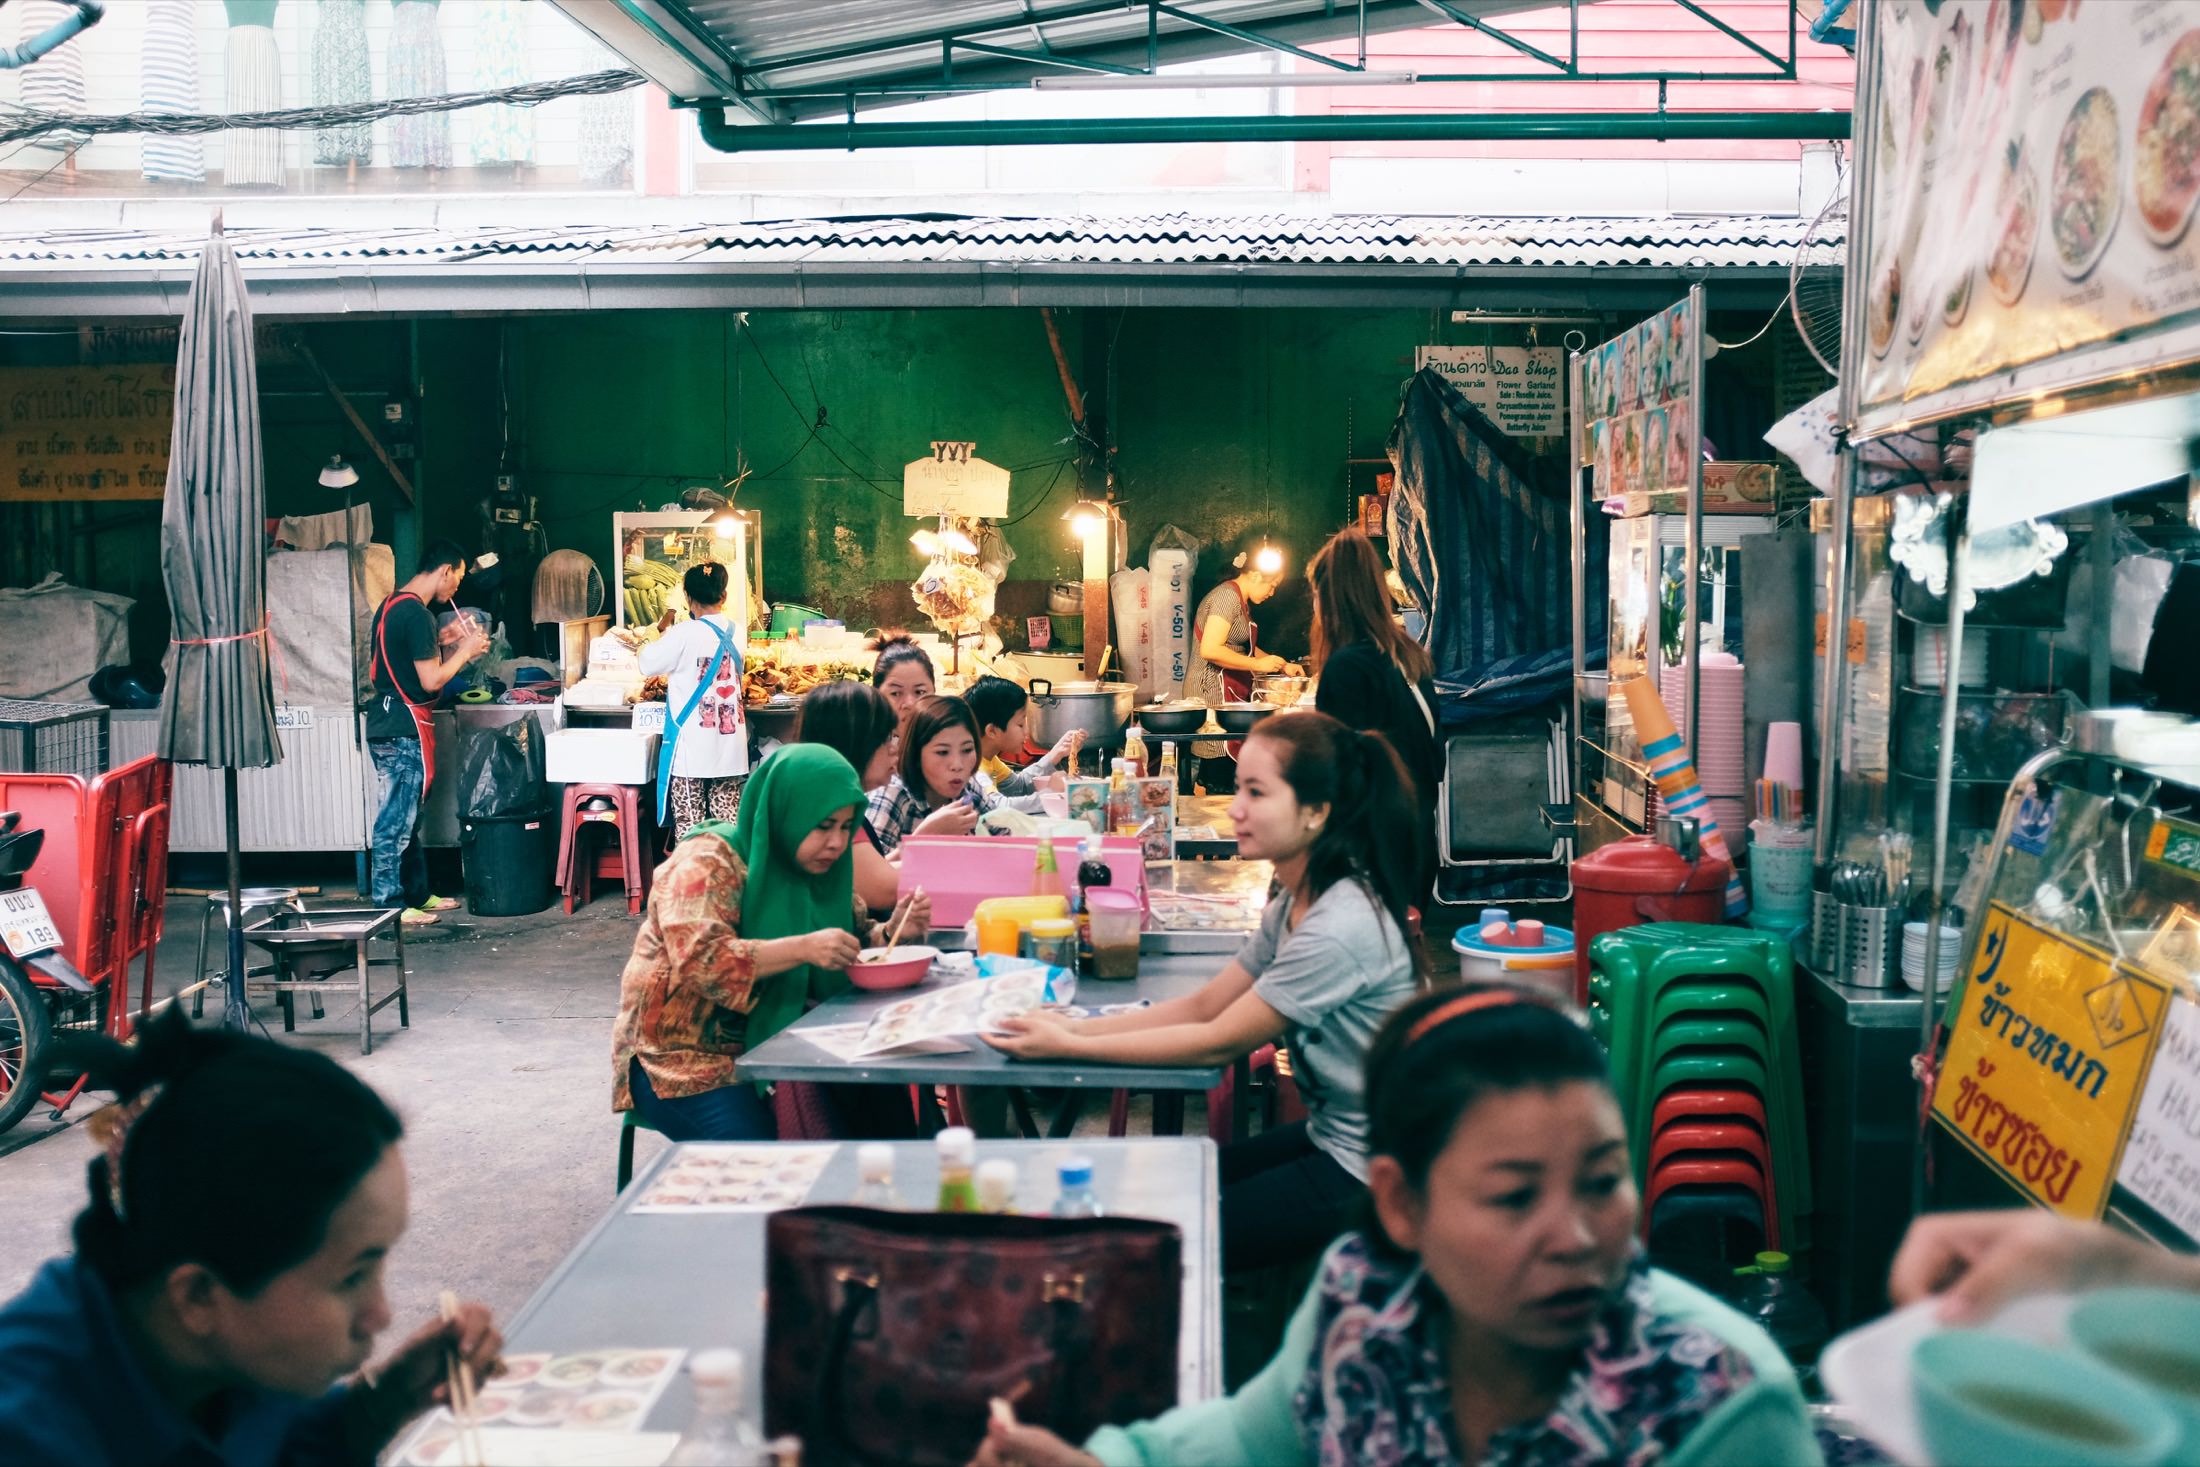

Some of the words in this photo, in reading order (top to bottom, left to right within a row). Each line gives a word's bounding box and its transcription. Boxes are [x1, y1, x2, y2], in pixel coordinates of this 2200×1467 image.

[1494, 359, 1519, 375] Dao
[1525, 359, 1557, 380] Shop
[1496, 380, 1521, 389] Flower
[1527, 380, 1556, 389] Garland
[1140, 622, 1148, 645] V-45
[1172, 604, 1184, 639] V-501
[1172, 652, 1184, 682] V-501
[27, 926, 55, 945] 189
[1979, 982, 2109, 1100] ข้าวหมก
[1953, 1056, 2082, 1204] ข้าวซอย
